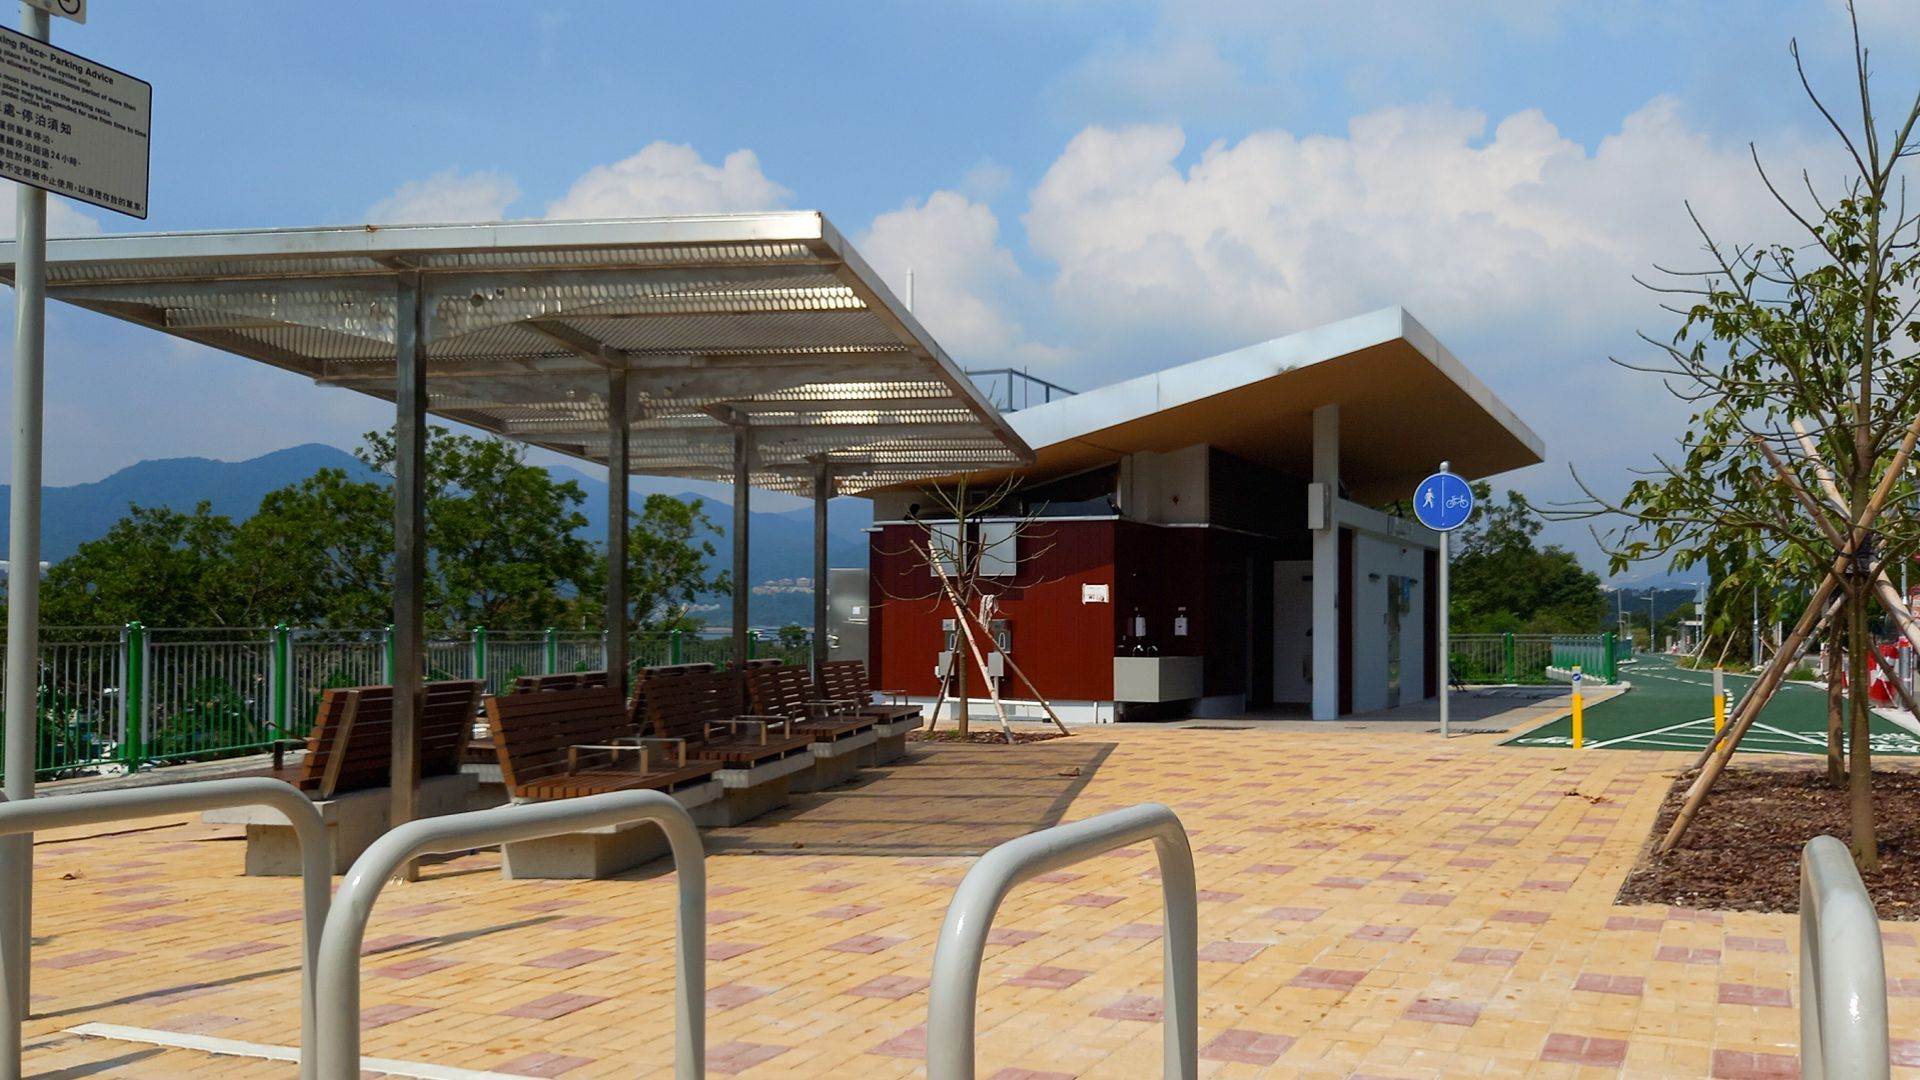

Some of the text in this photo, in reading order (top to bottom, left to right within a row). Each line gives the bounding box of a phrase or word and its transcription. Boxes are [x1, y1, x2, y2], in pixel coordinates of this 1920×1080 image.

[51, 53, 83, 74] Parking
[85, 67, 114, 85] Advice
[58, 70, 77, 80] cycles
[81, 87, 100, 97] period
[72, 99, 93, 111] parking
[0, 103, 72, 135] 處-停泊須知
[114, 122, 126, 131] time
